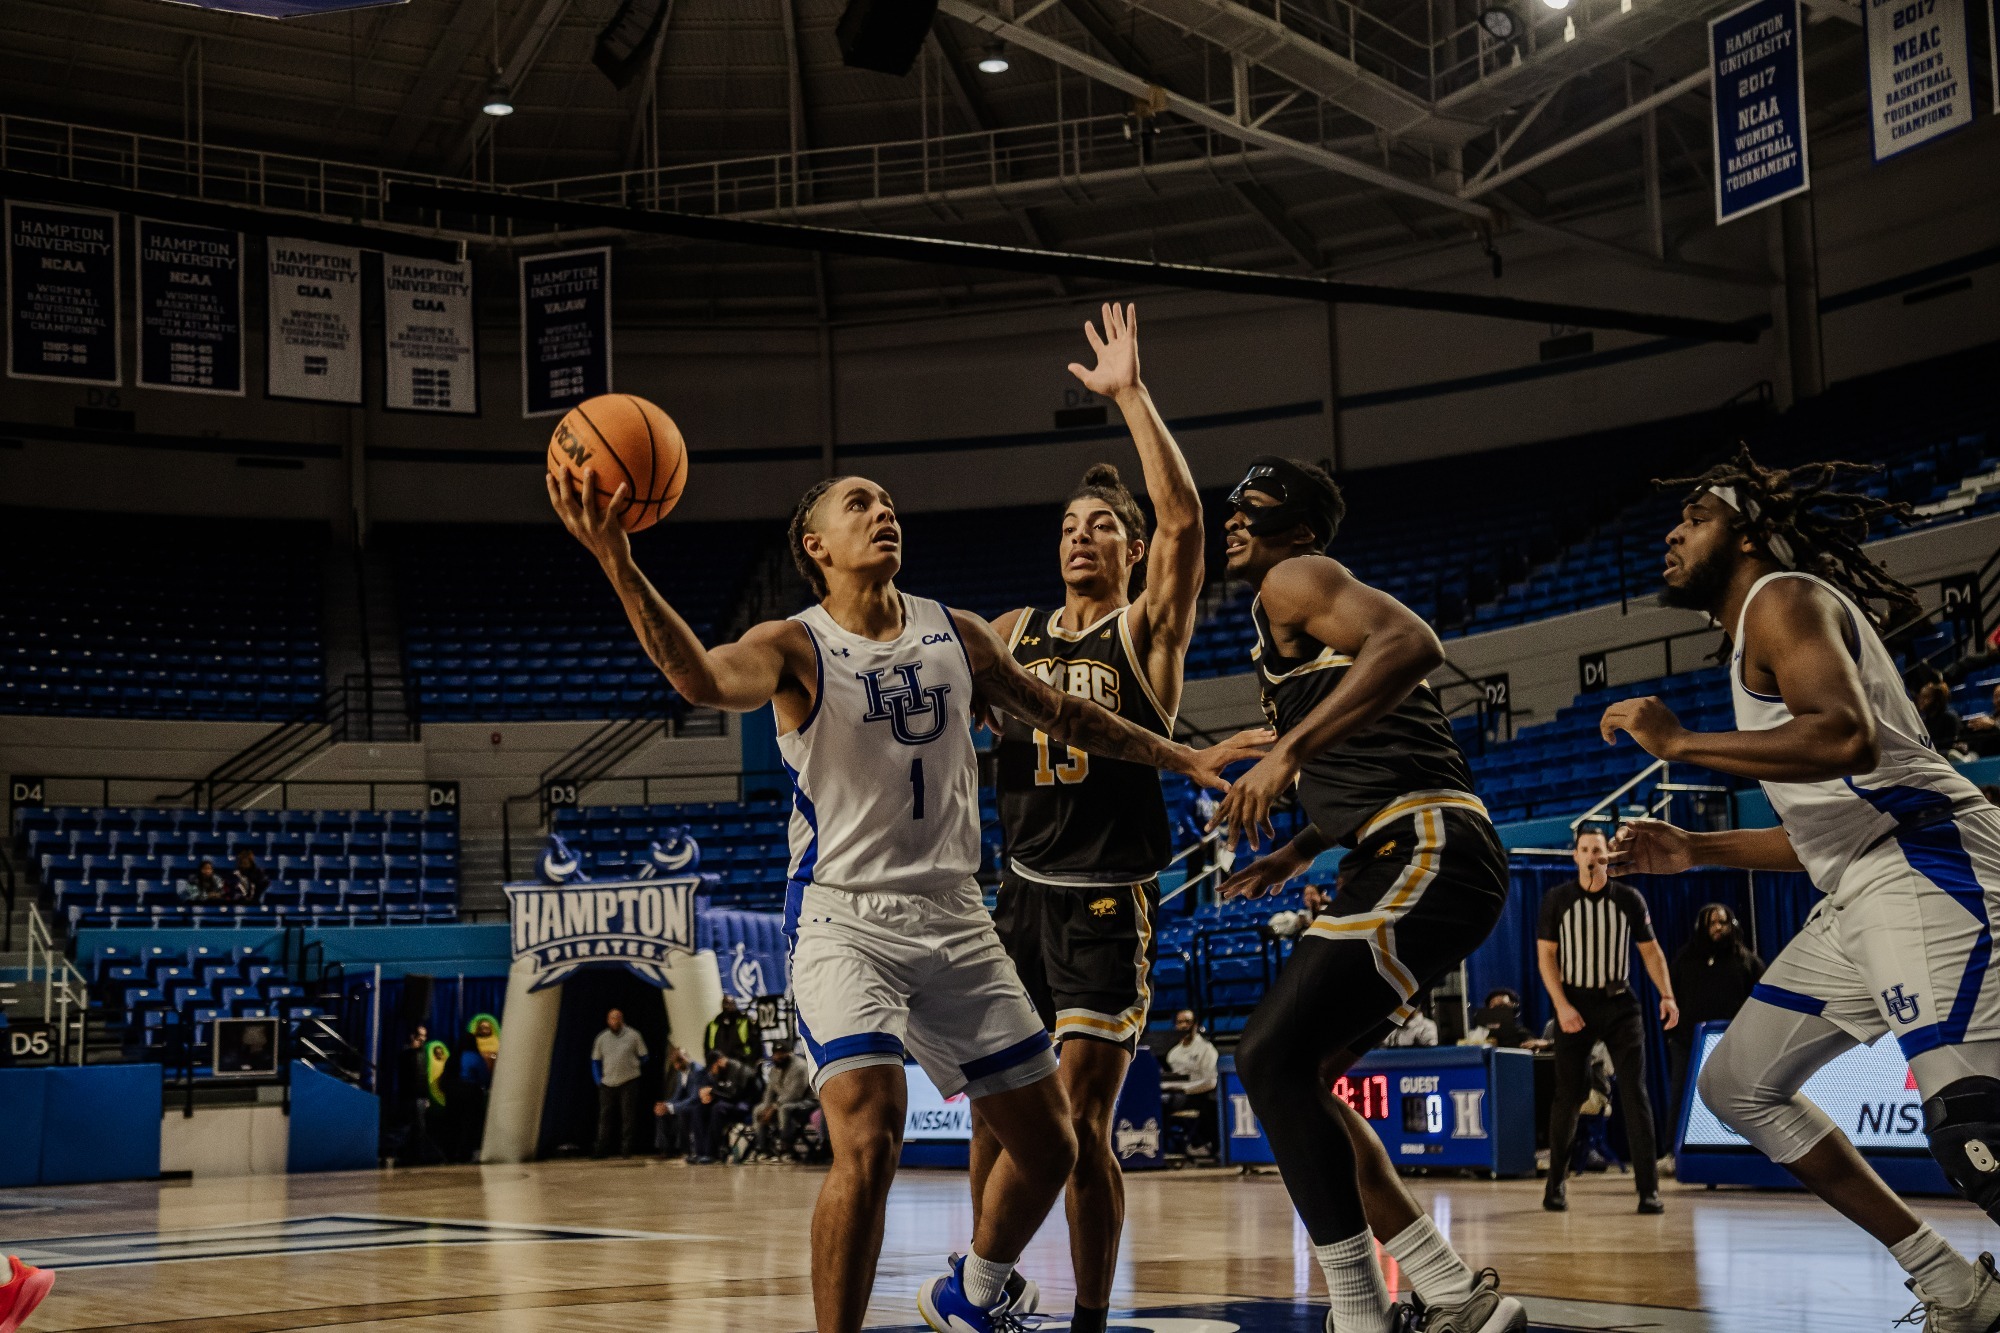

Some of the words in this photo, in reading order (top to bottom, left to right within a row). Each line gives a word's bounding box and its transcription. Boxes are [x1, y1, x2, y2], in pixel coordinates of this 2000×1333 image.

[1893, 0, 1935, 31] 2017
[1725, 13, 1784, 55] HAMPTON
[1893, 25, 1941, 66] MEAC
[1719, 29, 1793, 76] UNIVERSITY
[1893, 52, 1944, 85] WOMEN'S
[1737, 65, 1777, 99] 2017
[1886, 67, 1953, 106] BASKETBALL
[1737, 95, 1781, 132] NCAA
[1883, 82, 1958, 124] TOURNAMENT
[1892, 103, 1953, 140] CHAMPIONS
[1735, 118, 1784, 152] WOMEN'S
[1727, 134, 1794, 174] BASKETBALL
[1725, 151, 1798, 193] TOURNAMENT
[21, 220, 104, 241] HAMPTON
[15, 233, 110, 256] UNIVERSITY
[151, 234, 230, 255] HAMPTON
[41, 256, 87, 273] NCAA
[144, 248, 238, 270] UNIVERSITY
[276, 249, 351, 269] HAMPTON
[169, 271, 212, 287] NCAA
[271, 263, 357, 283] UNIVERSITY
[392, 265, 464, 283] HAMPTON
[532, 265, 598, 286] HAMPTON
[297, 284, 332, 299] CIAA
[387, 277, 469, 297] UNIVERSITY
[530, 277, 600, 299] INSTITUTE
[412, 299, 445, 312] CIAA
[922, 632, 953, 646] CAA
[1025, 657, 1121, 713] MBC
[1584, 661, 1605, 686] D1
[856, 660, 951, 745] HU
[1485, 682, 1506, 704] D2
[14, 783, 42, 801] D4
[430, 788, 456, 806] D4
[551, 785, 576, 804] D3
[909, 757, 926, 821] 1
[513, 884, 688, 950] HAMPTON
[547, 939, 656, 963] PIRATES
[1882, 983, 1919, 1024] HU
[11, 1031, 49, 1056] D5
[1400, 1076, 1440, 1094] GUEST
[909, 1111, 964, 1130] NISSAN
[1449, 1089, 1488, 1139] H
